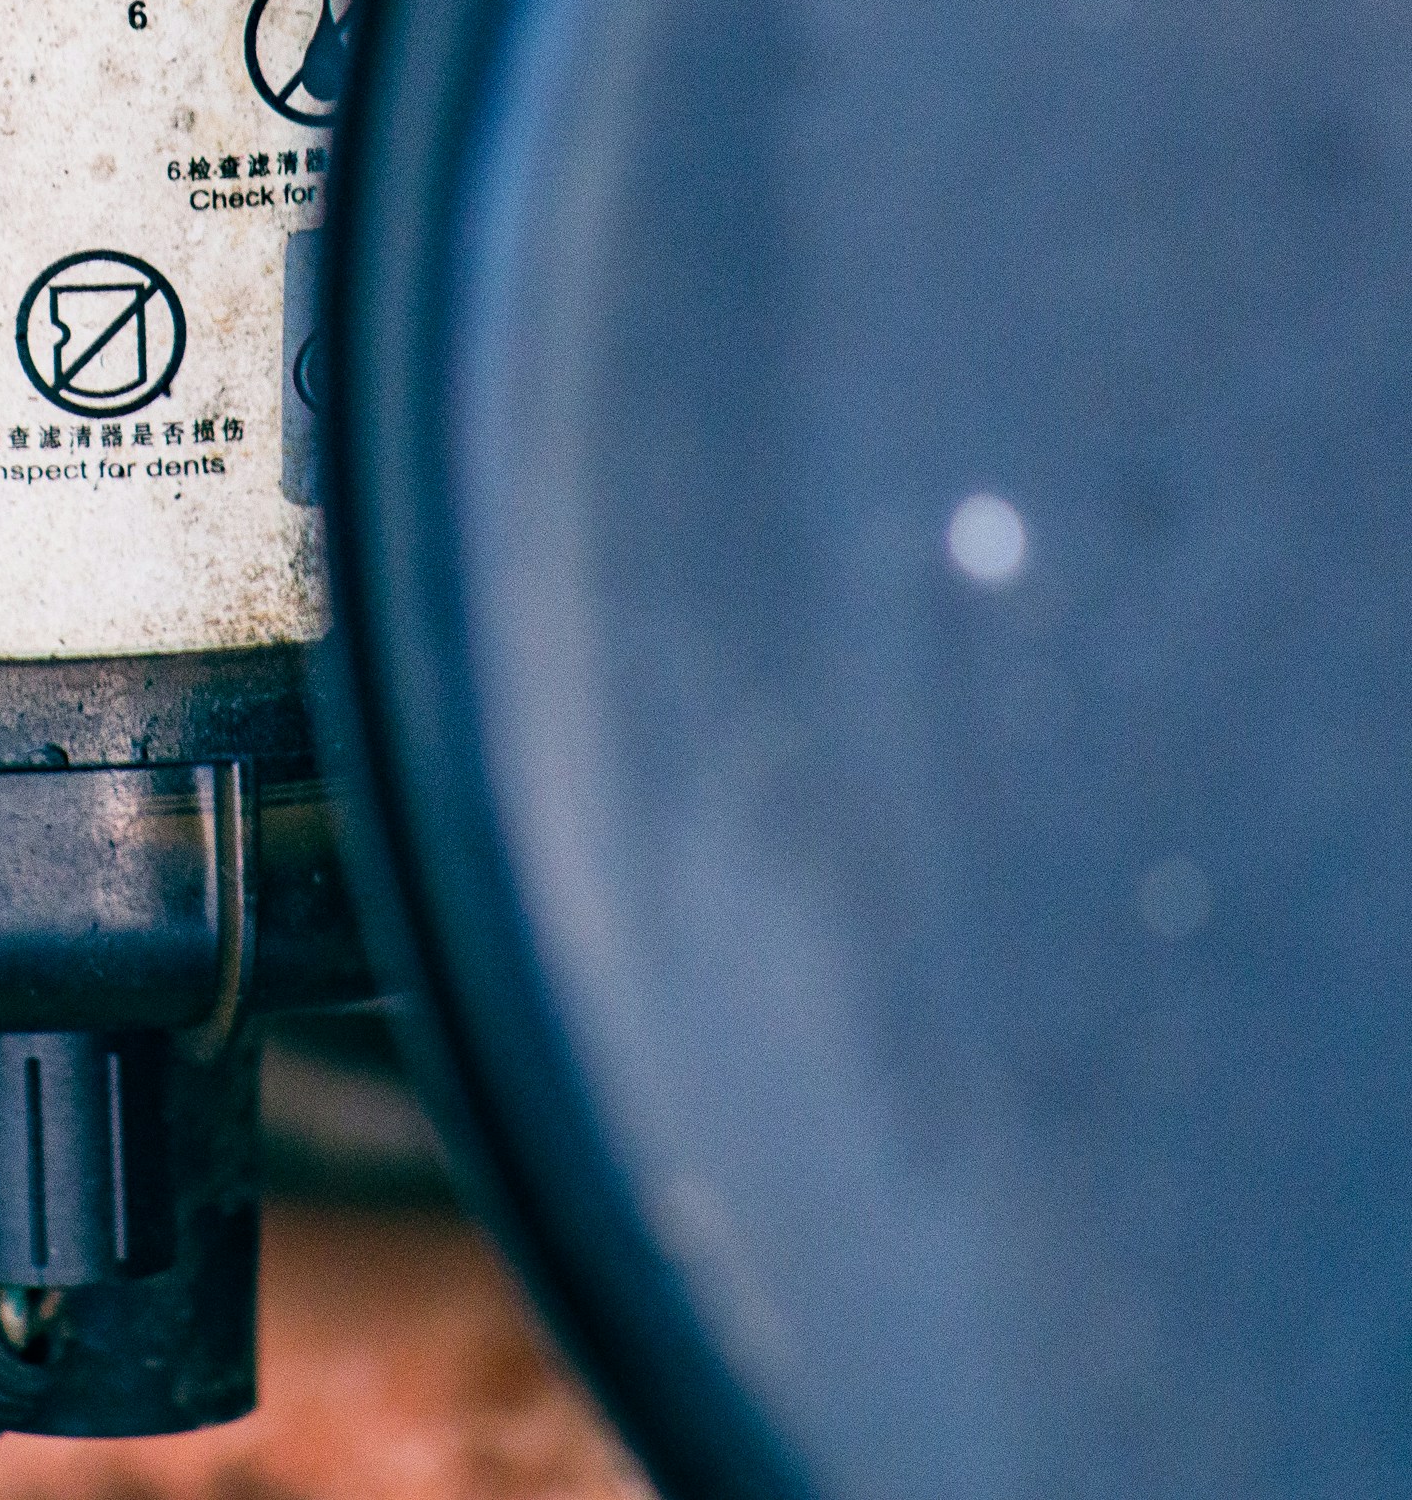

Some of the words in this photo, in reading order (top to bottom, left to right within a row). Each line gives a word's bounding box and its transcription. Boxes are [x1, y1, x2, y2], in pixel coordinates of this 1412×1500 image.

[128, 0, 148, 30] 6
[189, 185, 275, 211] Check
[284, 183, 316, 204] for
[98, 459, 135, 478] for
[146, 455, 225, 477] dents
